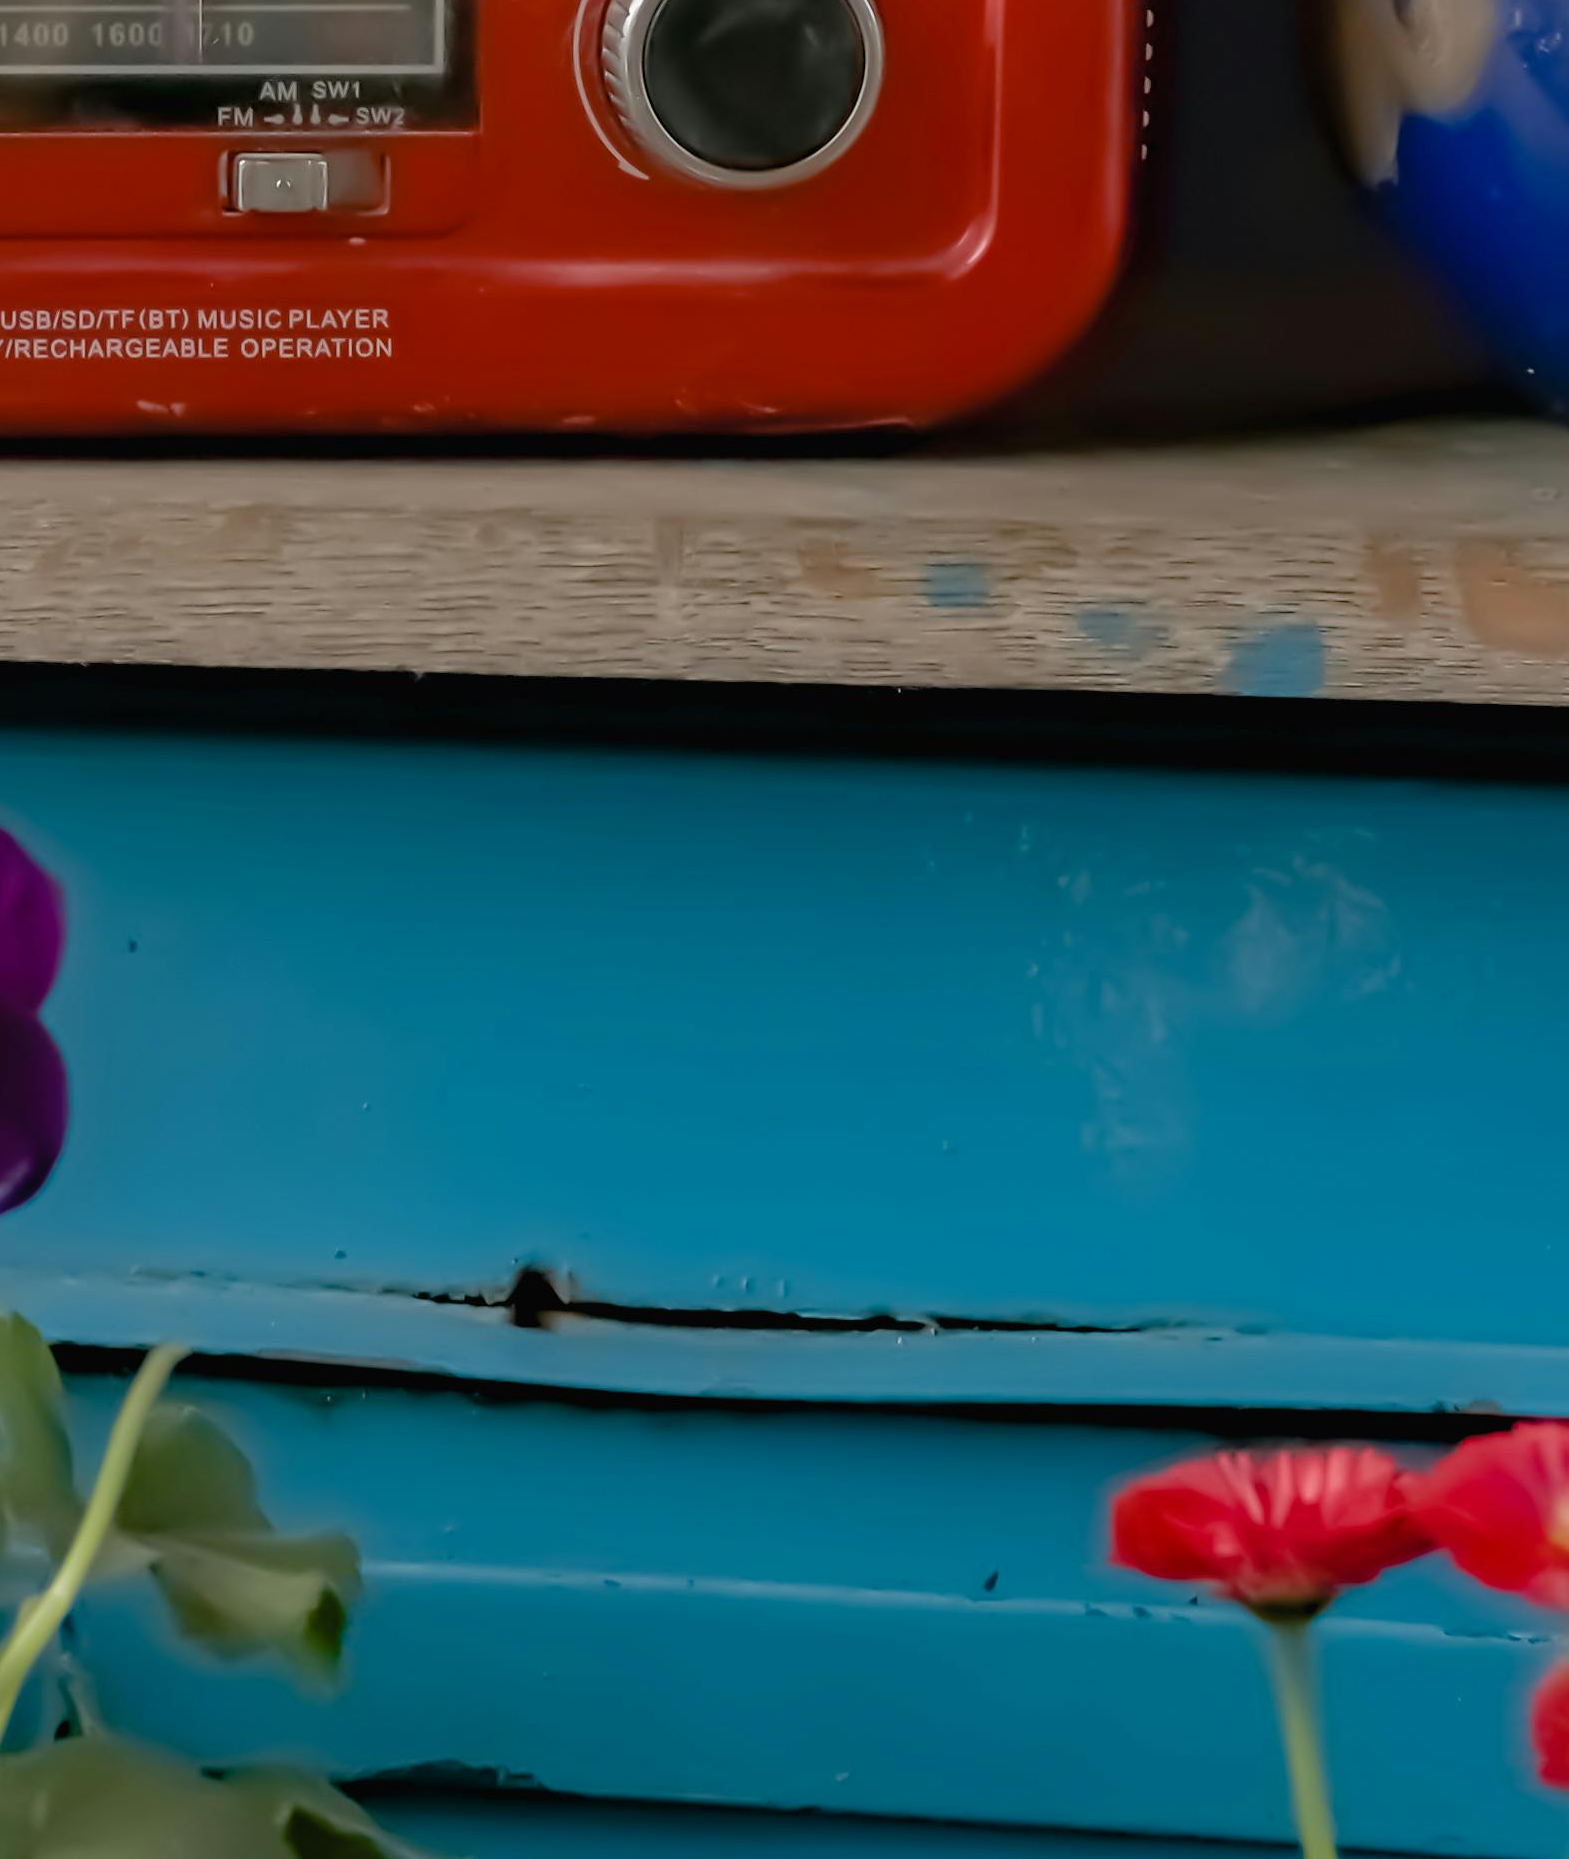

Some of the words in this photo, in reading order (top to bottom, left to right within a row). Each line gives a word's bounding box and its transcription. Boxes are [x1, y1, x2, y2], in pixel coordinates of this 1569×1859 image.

[91, 22, 163, 47] 1600
[259, 81, 297, 102] AM
[312, 80, 361, 101] SW1
[217, 107, 254, 127] FM
[356, 106, 405, 126] SW2
[198, 309, 281, 329] MUSIC
[289, 309, 389, 329] PLAYER
[241, 338, 393, 359] OPERATION
